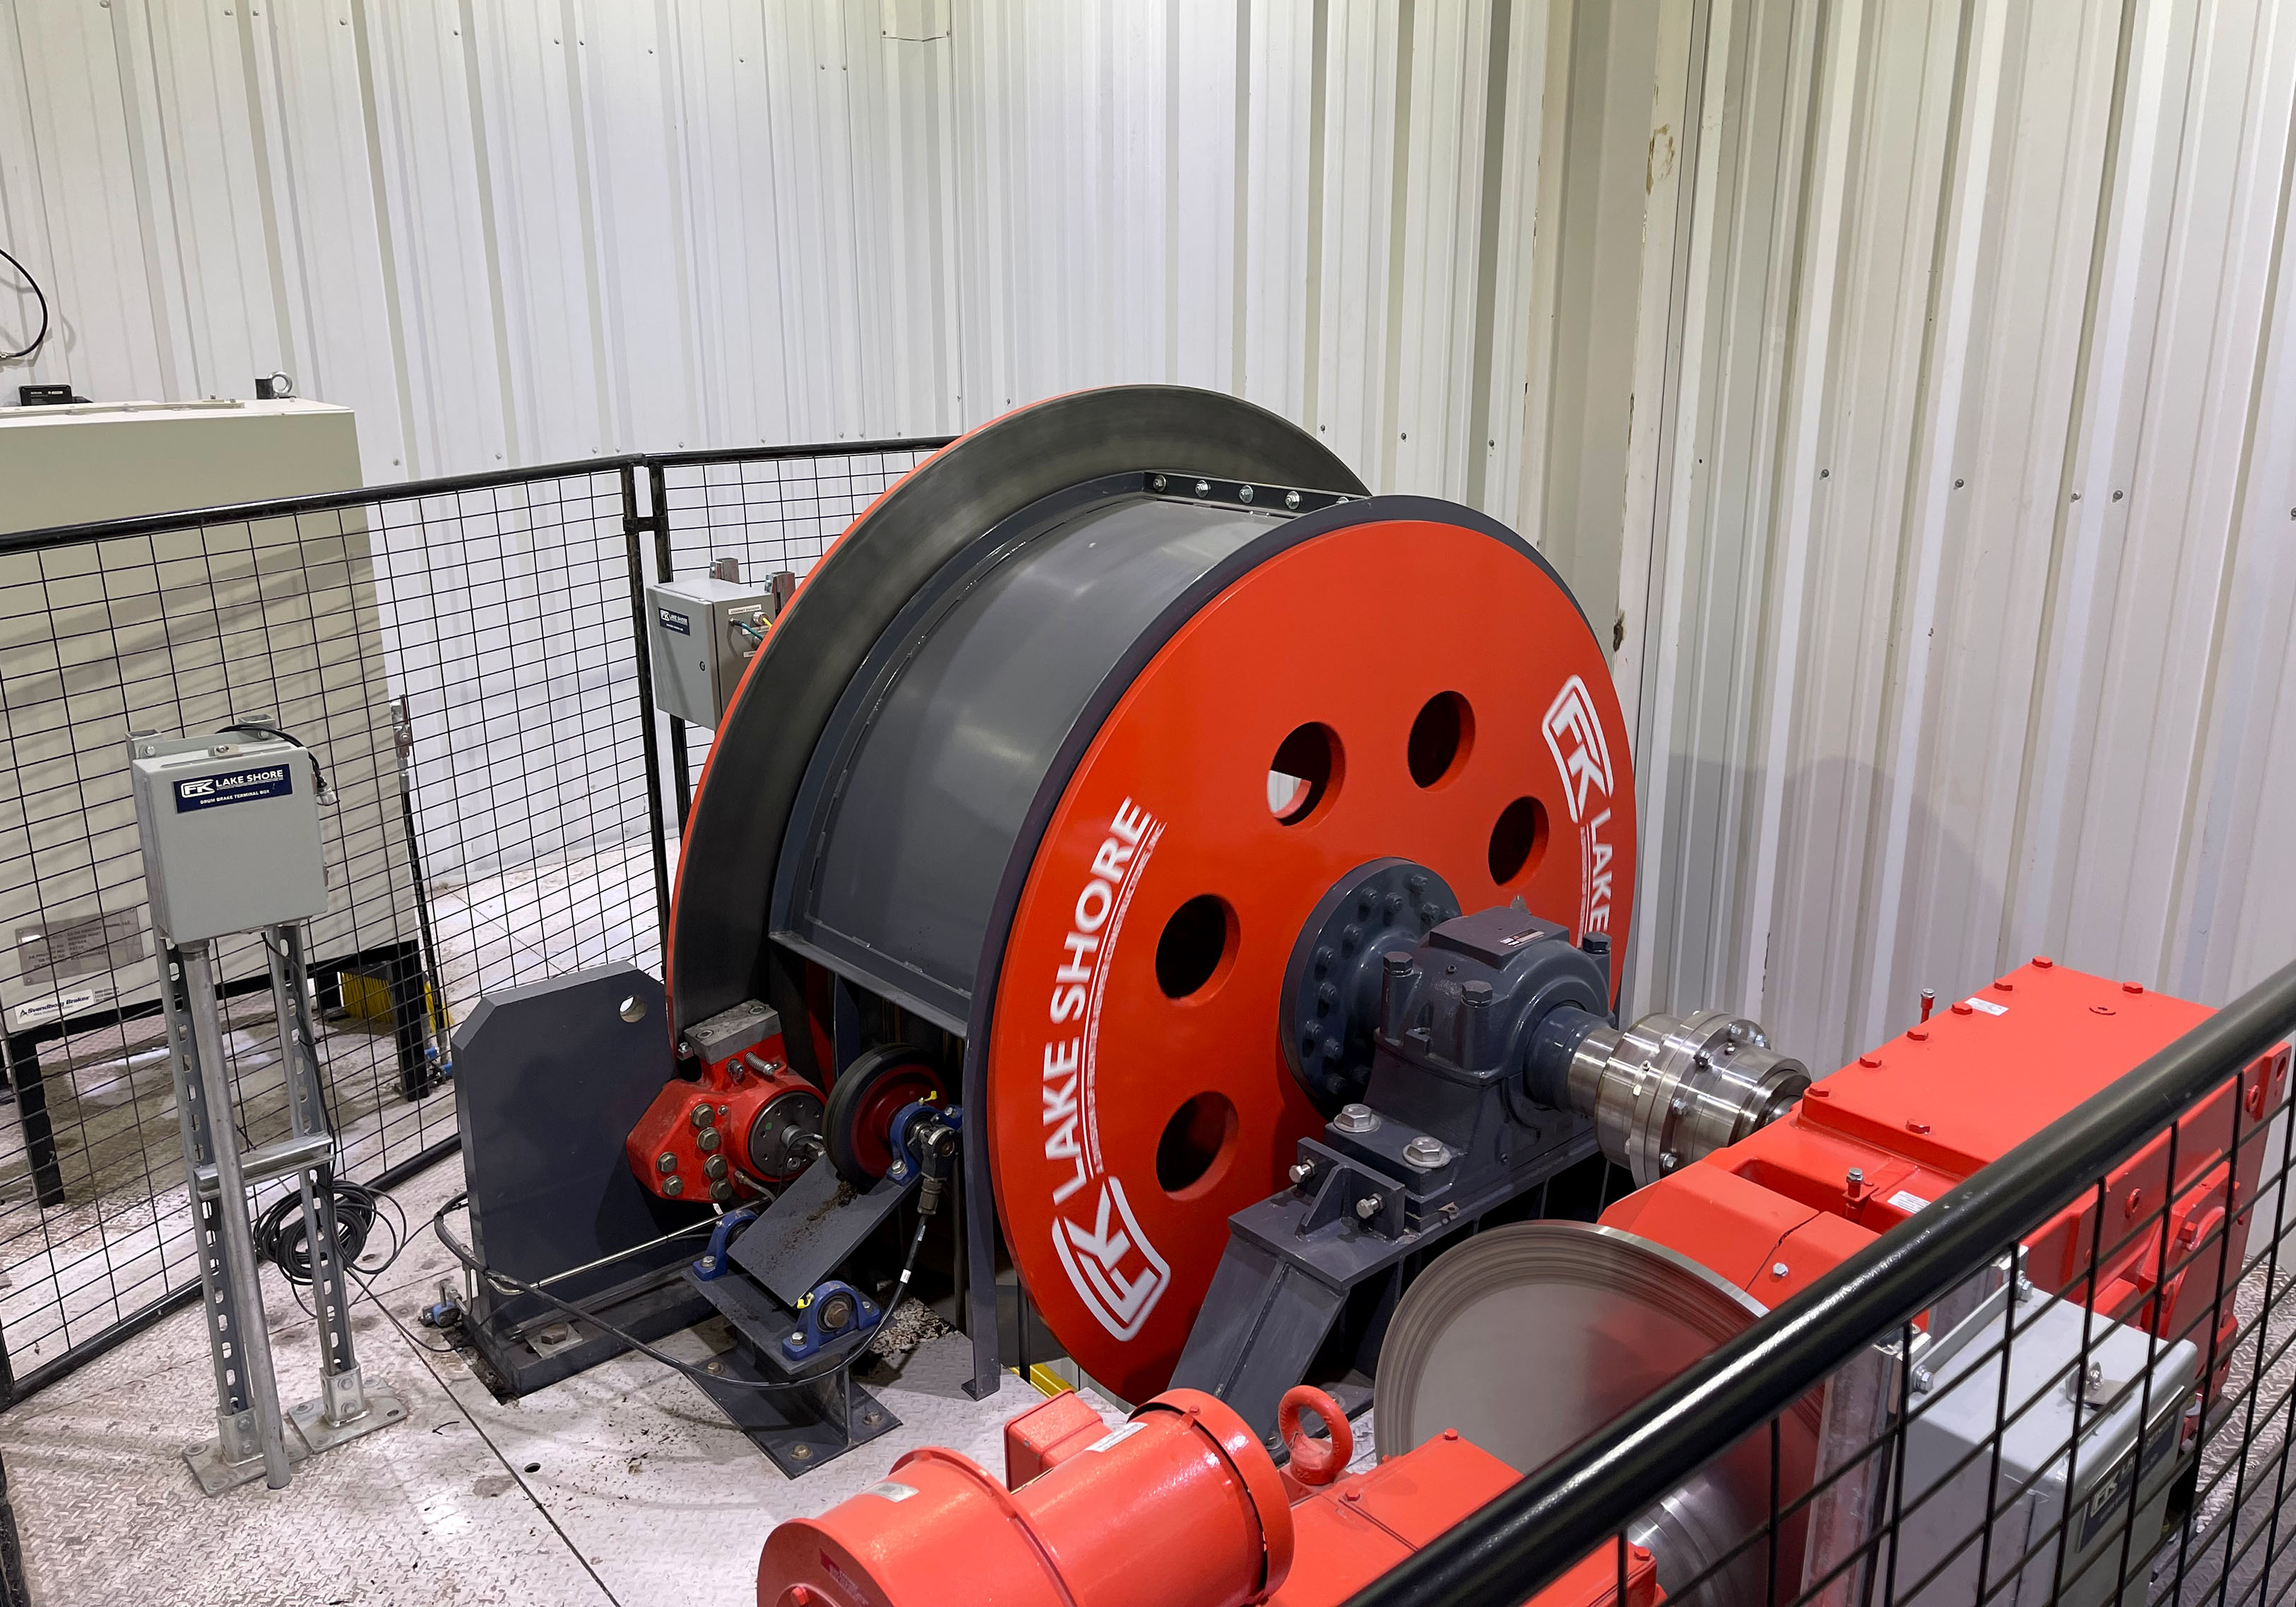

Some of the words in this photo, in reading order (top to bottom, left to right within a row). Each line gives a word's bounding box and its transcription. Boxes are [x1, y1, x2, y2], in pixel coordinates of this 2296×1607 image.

[215, 776, 244, 787] LAKE
[247, 770, 283, 782] SHORE
[1050, 795, 1153, 1024] SHORE
[1590, 807, 1613, 933] LAKE
[28, 1002, 64, 1014] Svendbog
[1042, 1036, 1087, 1205] LAKE
